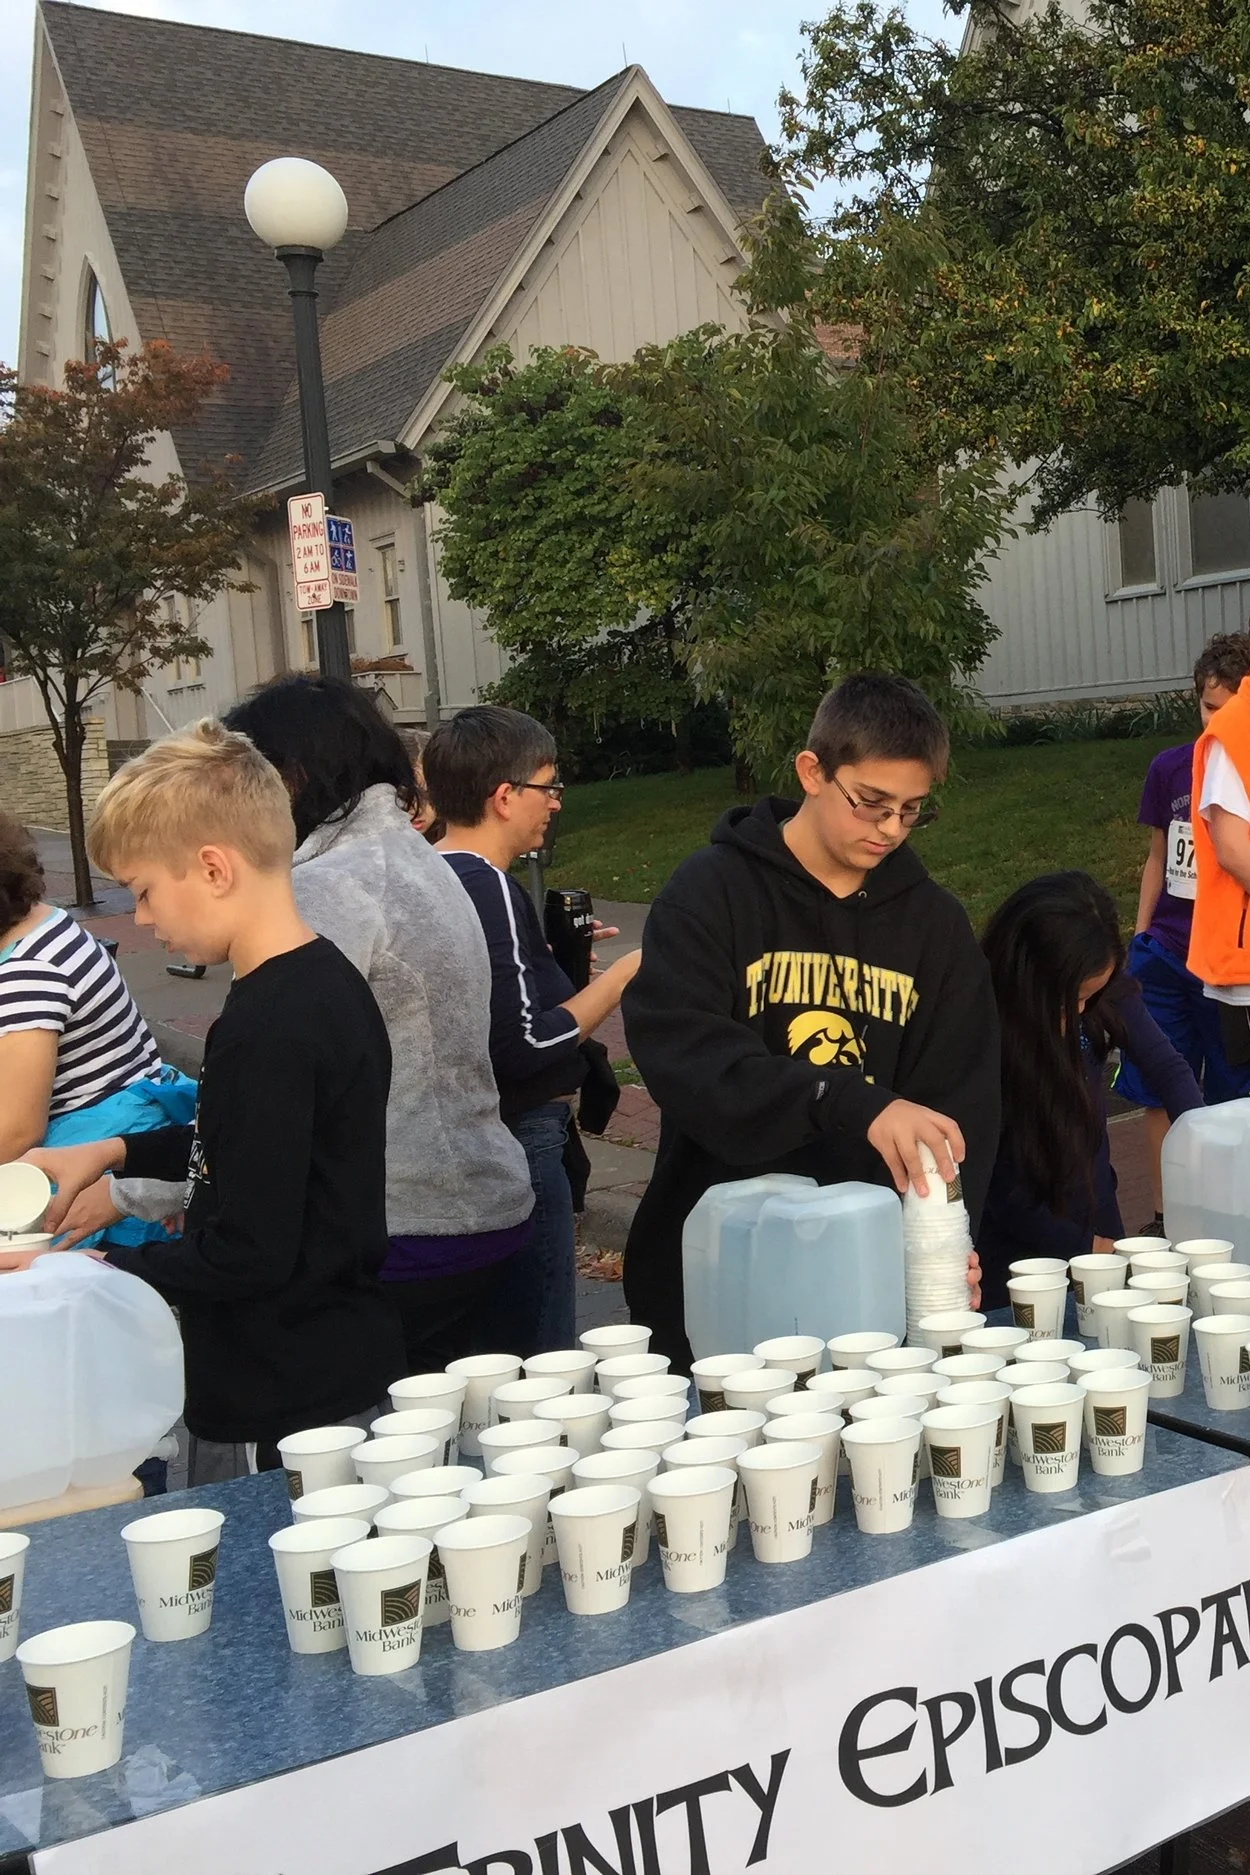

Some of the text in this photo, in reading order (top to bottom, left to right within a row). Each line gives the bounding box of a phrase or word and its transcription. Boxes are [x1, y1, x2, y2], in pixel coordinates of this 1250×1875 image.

[301, 503, 312, 519] NO
[293, 521, 324, 540] PARKING
[296, 544, 324, 559] 2 AM TO
[309, 562, 320, 573] AM
[1171, 794, 1191, 812] NOR
[1152, 1372, 1177, 1382] Bank
[1098, 1447, 1126, 1457] Bank
[1035, 1463, 1065, 1475] Bank
[424, 1589, 445, 1605] ank
[289, 1605, 343, 1621] MidWes
[313, 1617, 344, 1633] Ban
[355, 1615, 423, 1642] MidWestO
[382, 1632, 416, 1652] Bank
[38, 1724, 98, 1741] estOne
[38, 1742, 62, 1755] ank
[366, 1748, 792, 1875] NITY
